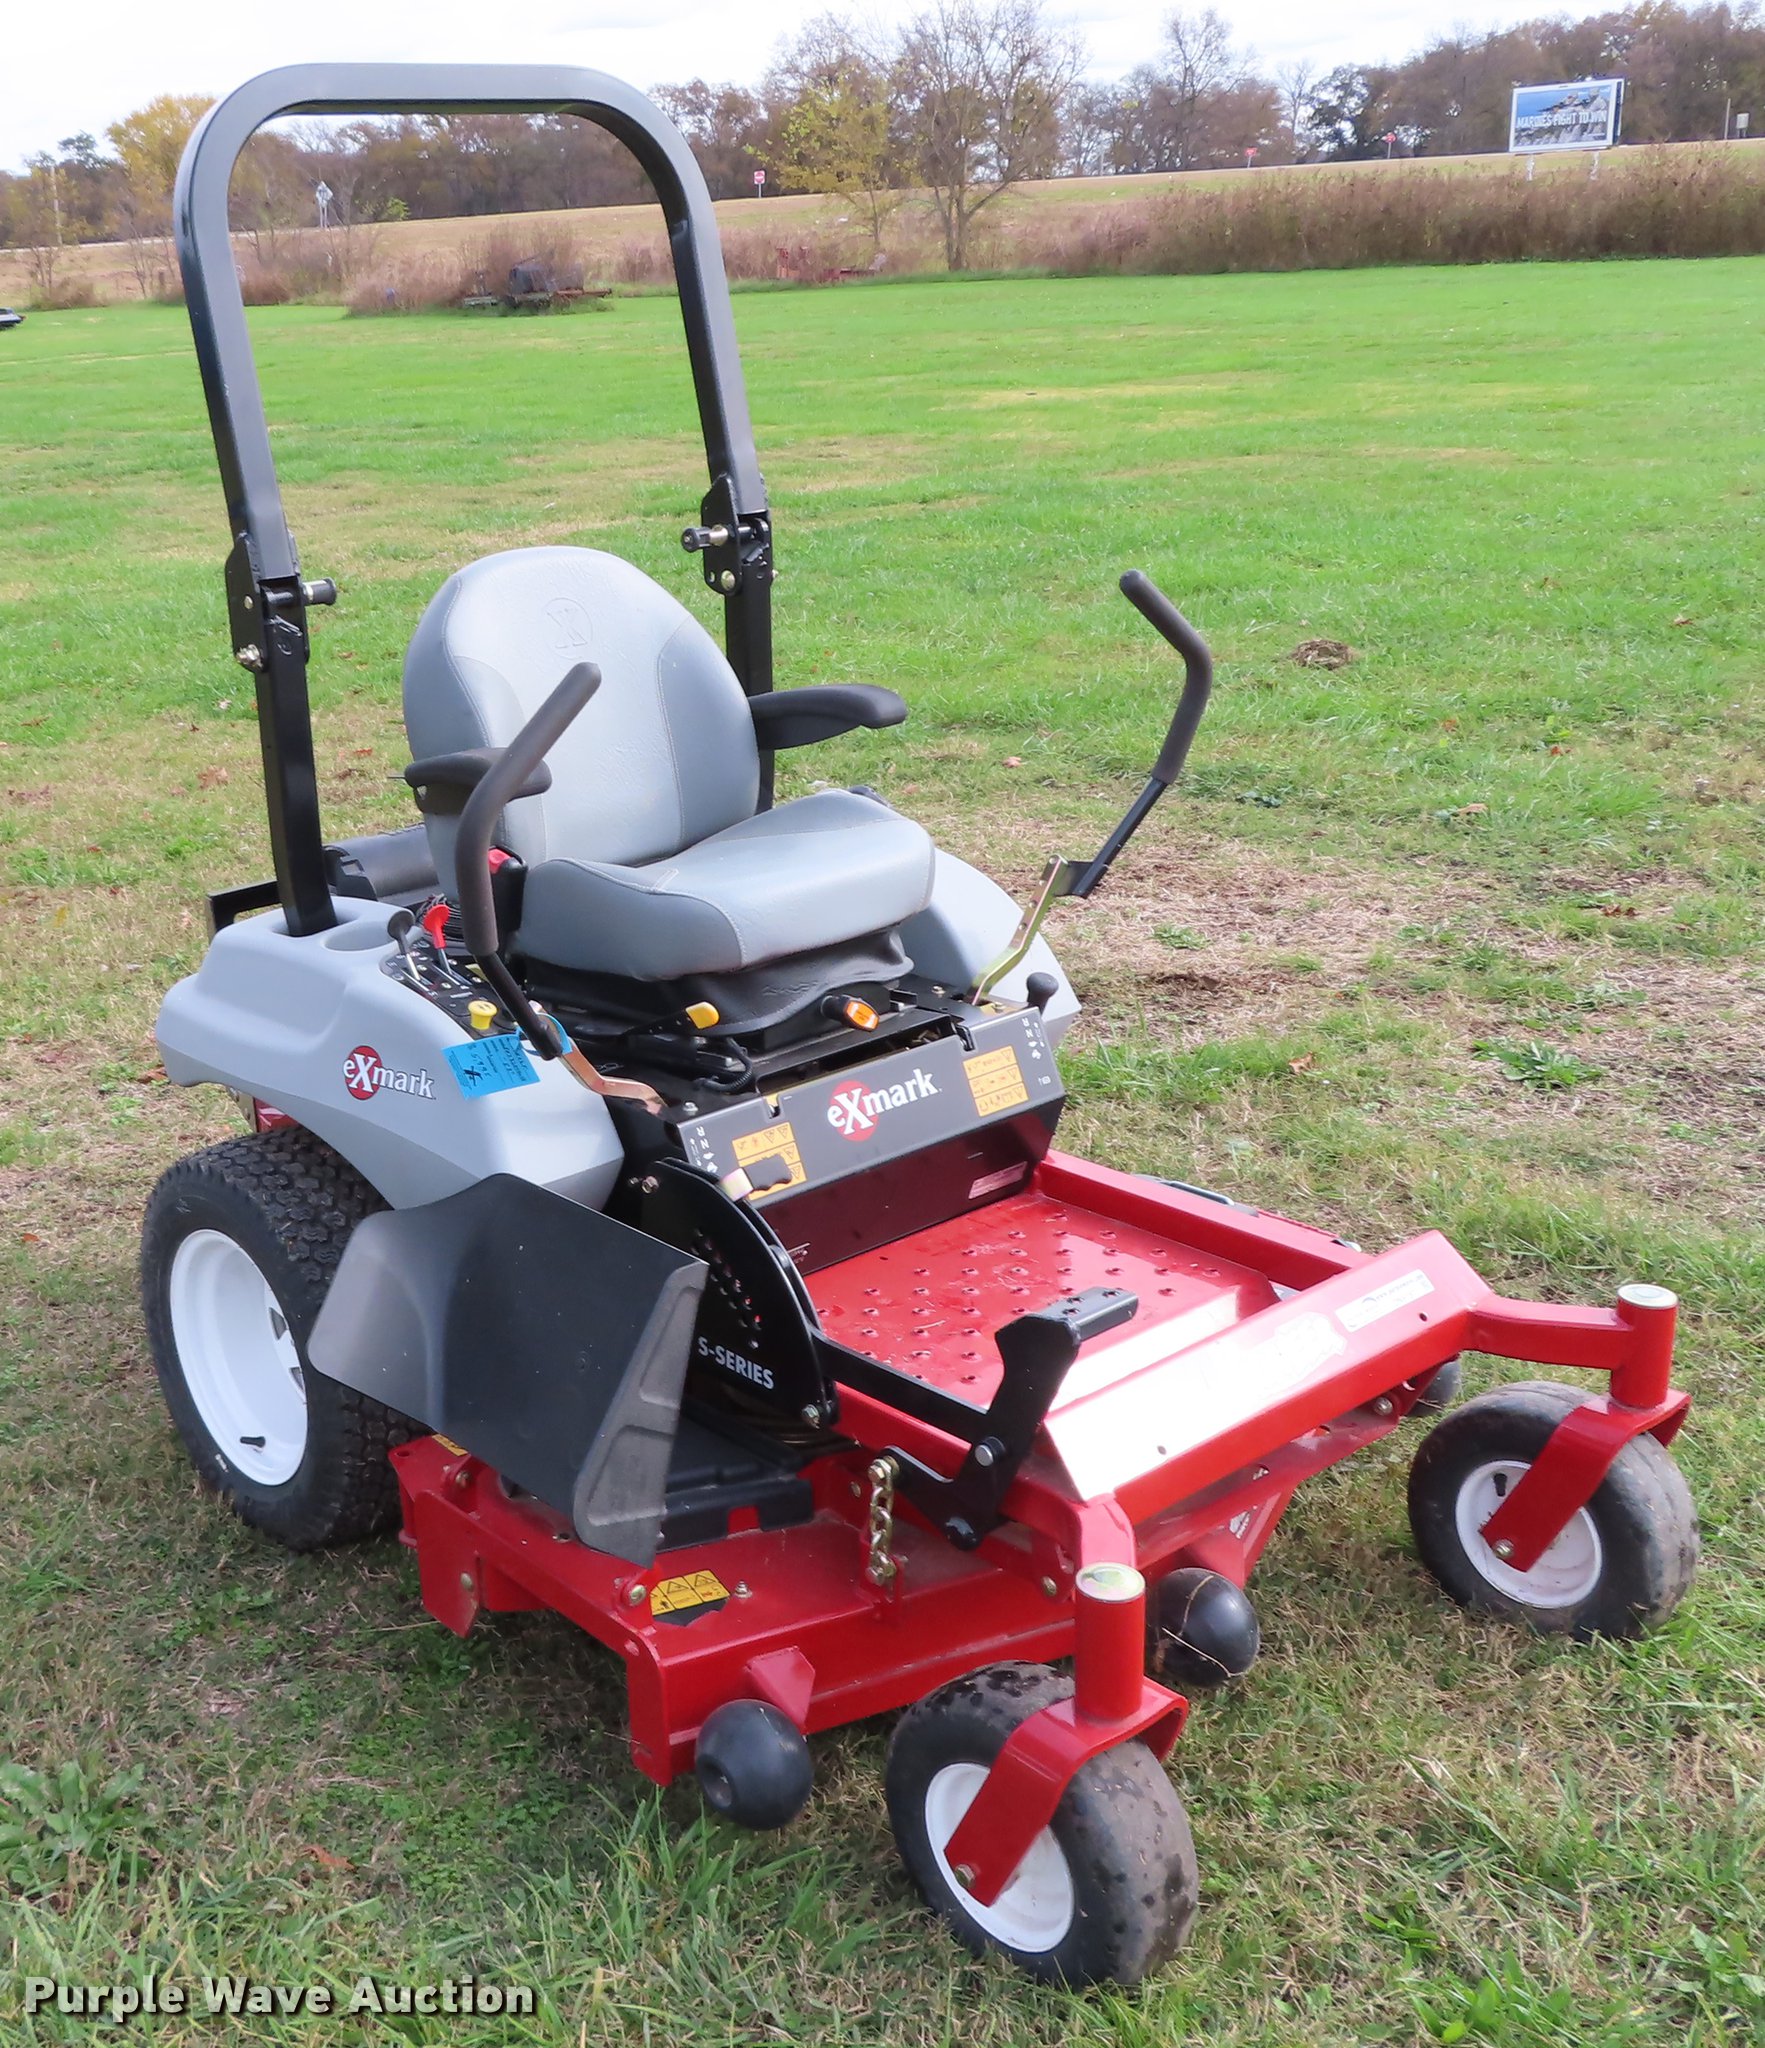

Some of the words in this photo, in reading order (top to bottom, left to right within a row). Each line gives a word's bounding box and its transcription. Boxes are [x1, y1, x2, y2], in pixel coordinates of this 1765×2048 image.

[1553, 111, 1577, 126] FIGHT
[1579, 110, 1589, 124] TO
[343, 1053, 434, 1099] eXmark
[827, 1068, 939, 1135] eXmark
[698, 1336, 774, 1389] S-SERIES
